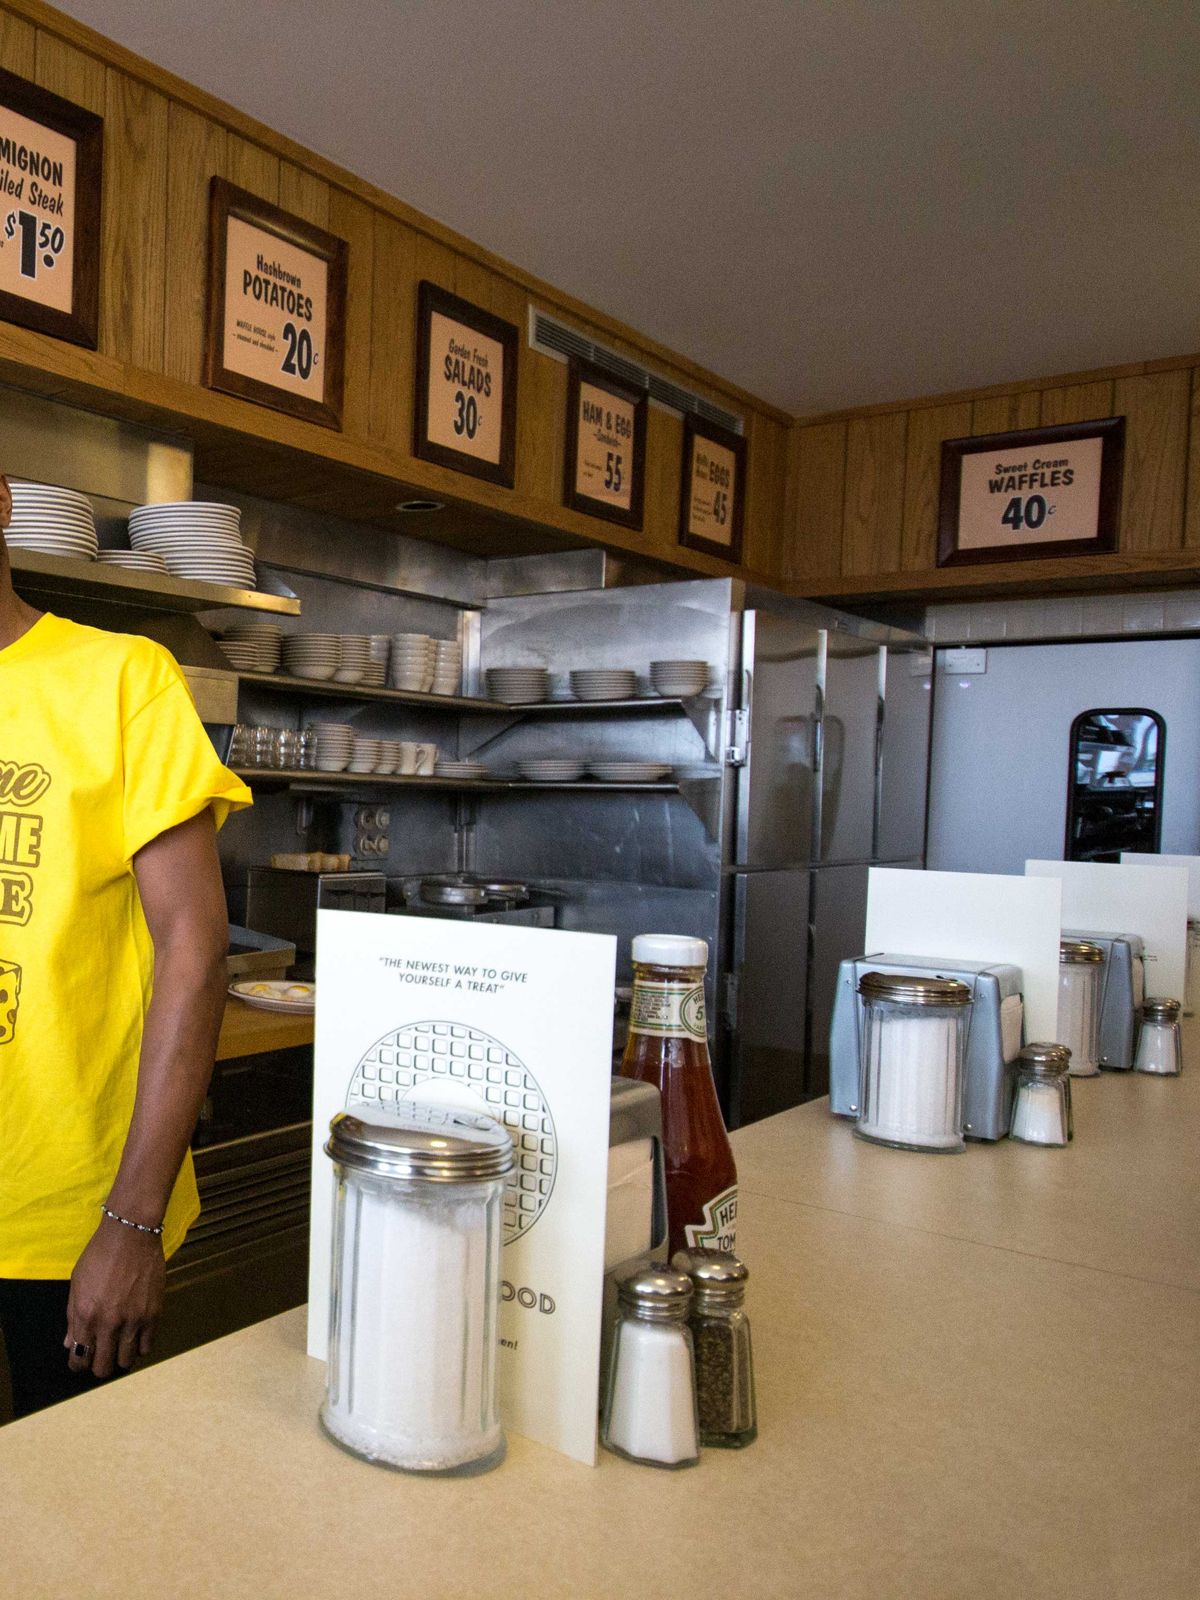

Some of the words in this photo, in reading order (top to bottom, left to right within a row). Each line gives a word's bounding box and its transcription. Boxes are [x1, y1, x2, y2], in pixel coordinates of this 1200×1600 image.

[29, 182, 64, 216] Steak
[256, 254, 302, 288] Hashbrown
[243, 269, 313, 322] POTATOES
[444, 354, 492, 397] SALADS
[582, 401, 603, 427] HAM
[995, 462, 1028, 475] Sweet
[1033, 459, 1069, 471] Cream
[988, 469, 1075, 493] WAFFLES
[399, 973, 451, 988] YOURSELF
[455, 979, 463, 989] A
[406, 960, 450, 973] NEWEST
[454, 965, 478, 977] WAY
[482, 968, 497, 979] TO
[501, 970, 528, 983] GIVE
